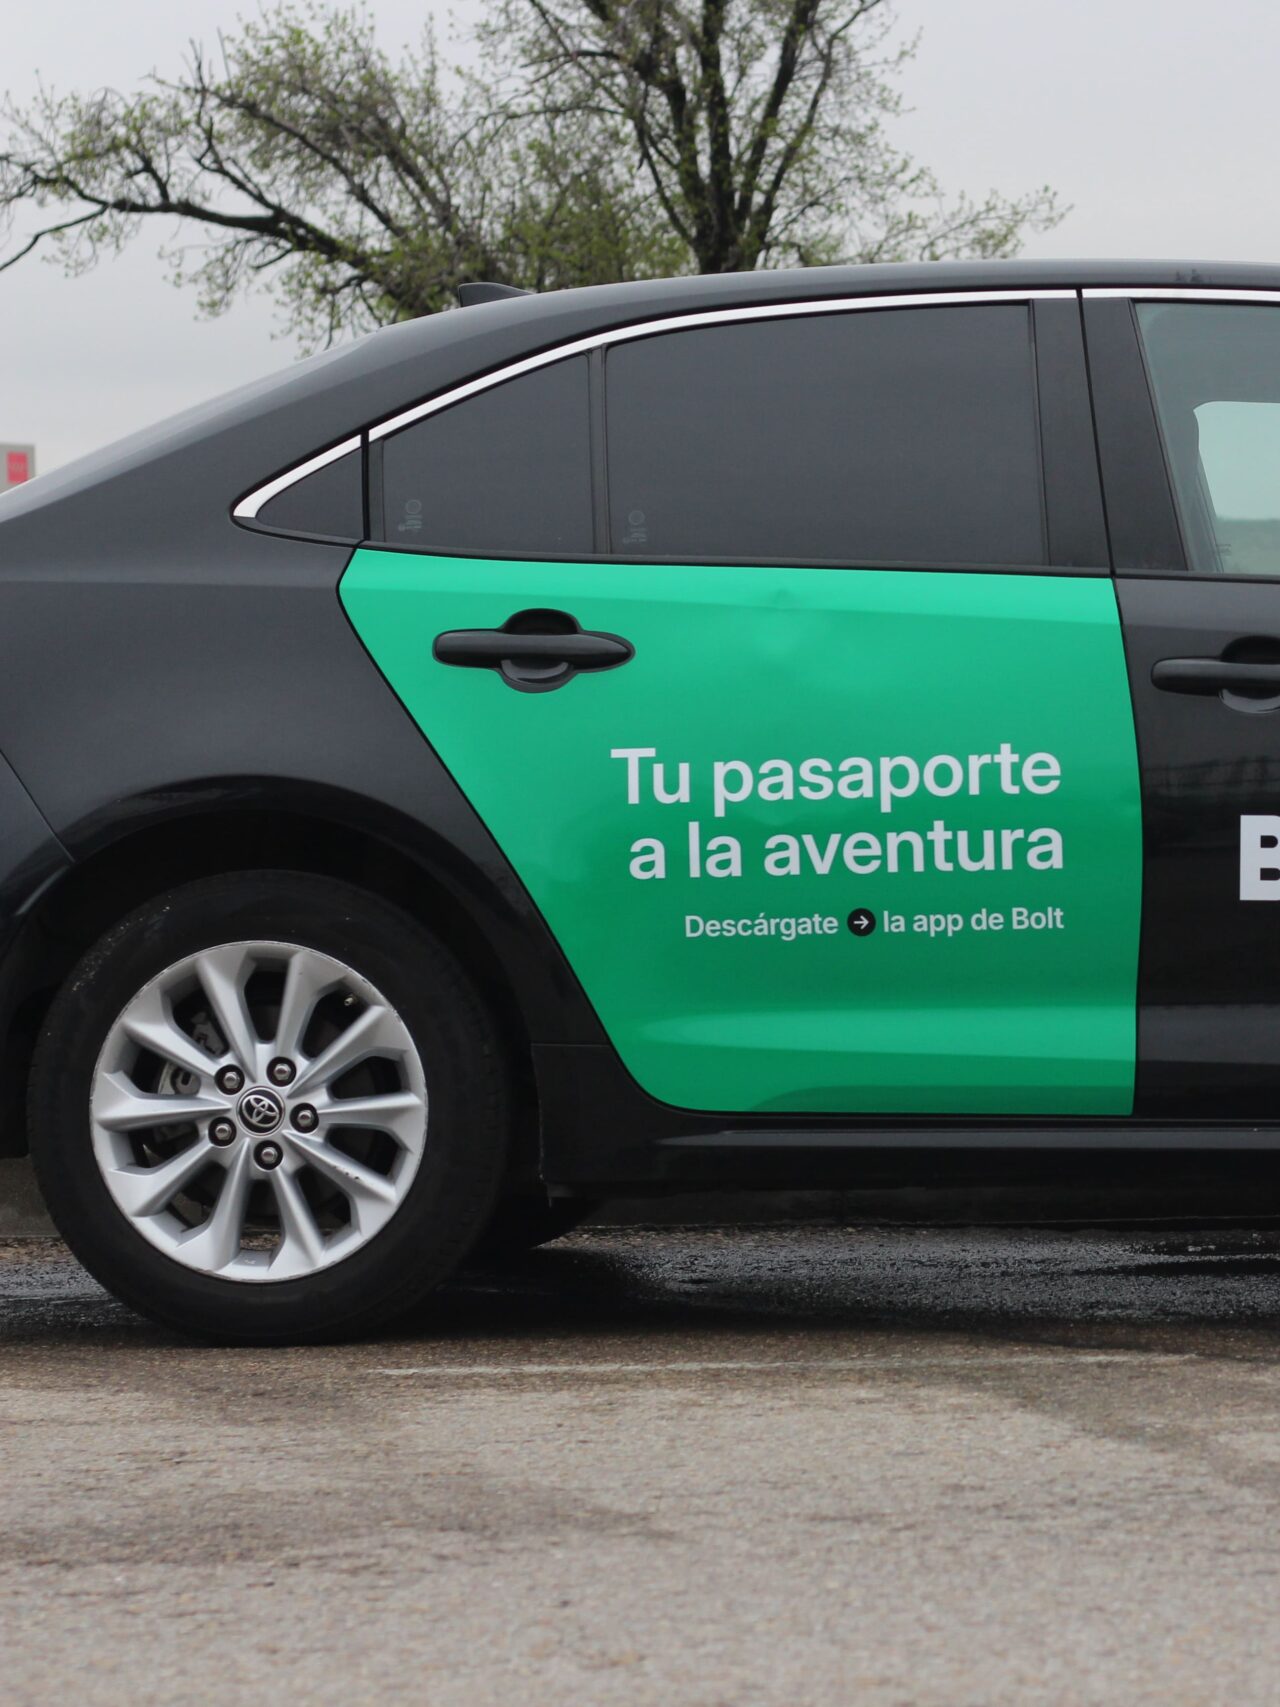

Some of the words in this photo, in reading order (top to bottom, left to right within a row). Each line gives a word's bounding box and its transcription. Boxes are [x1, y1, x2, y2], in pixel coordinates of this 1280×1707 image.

[611, 747, 690, 805] Tu
[713, 743, 1061, 818] pasaporte
[629, 837, 666, 880] a
[688, 820, 742, 878] la
[764, 820, 1064, 876] aventura
[685, 912, 839, 941] Descárgate
[883, 910, 905, 933] la
[913, 914, 964, 937] app
[970, 908, 1004, 931] de
[1012, 907, 1065, 930] Bolt
